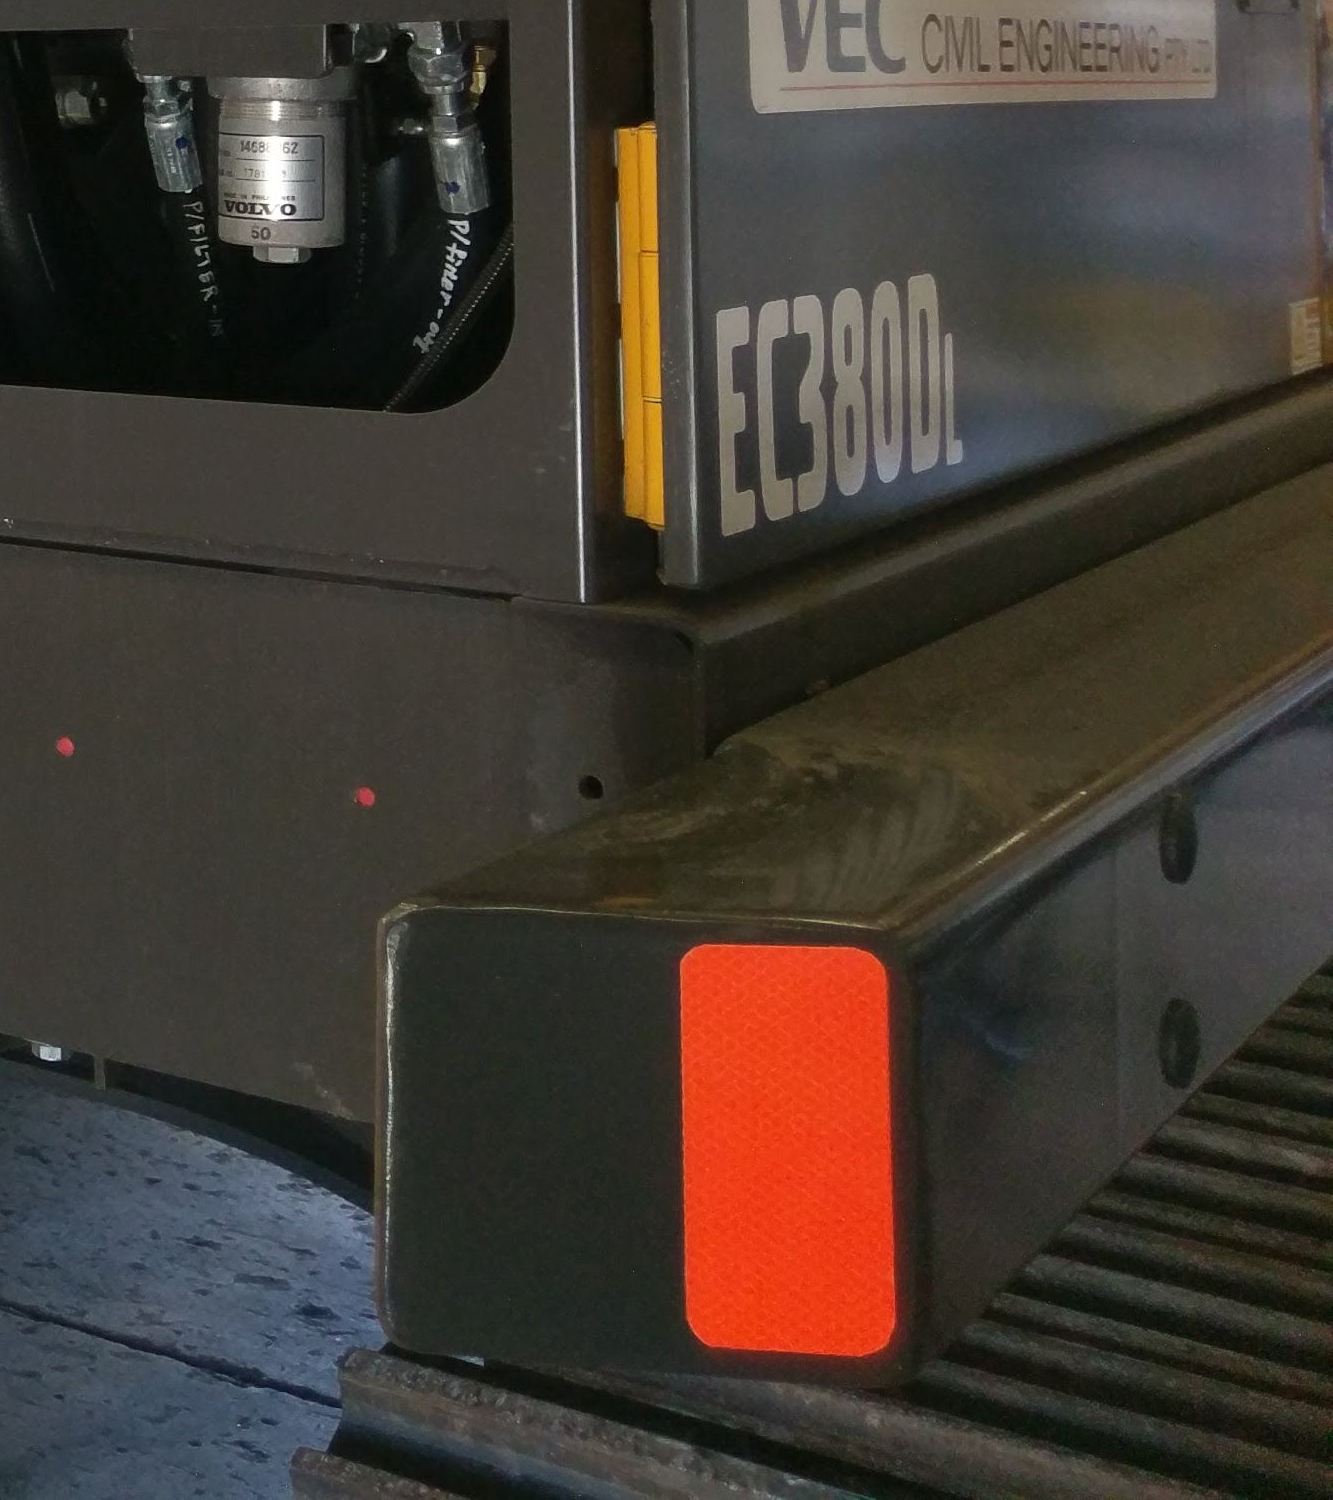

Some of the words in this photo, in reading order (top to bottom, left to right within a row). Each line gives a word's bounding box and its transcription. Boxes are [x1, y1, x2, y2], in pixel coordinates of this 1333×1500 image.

[921, 13, 991, 74] CIVIL
[998, 16, 1161, 74] ENGINEERING
[224, 200, 297, 216] VOLVO
[716, 273, 964, 537] EC380DL
